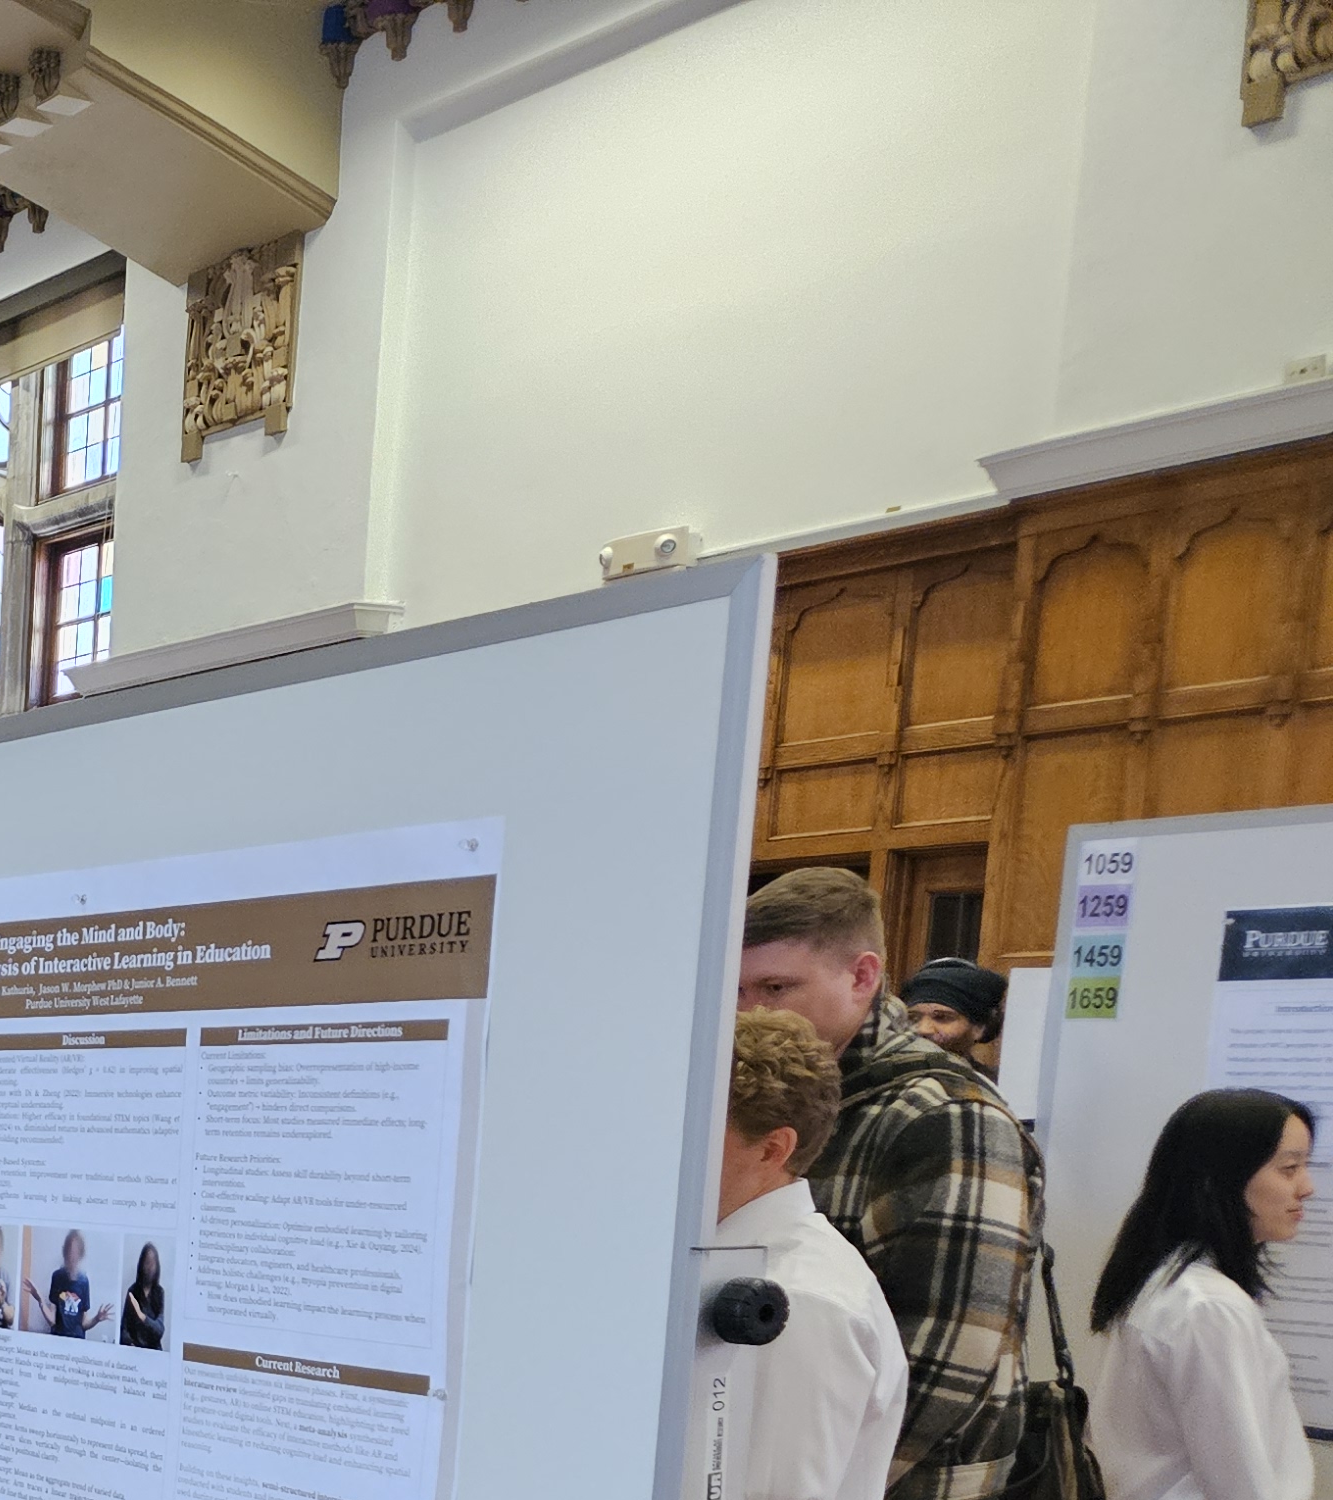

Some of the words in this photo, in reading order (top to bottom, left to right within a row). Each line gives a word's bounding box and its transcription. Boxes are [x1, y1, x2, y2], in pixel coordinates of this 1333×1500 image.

[1084, 852, 1134, 875] 1059
[1079, 894, 1129, 918] 1259
[57, 928, 79, 946] the
[81, 924, 115, 944] Mind
[117, 921, 143, 941] and
[146, 918, 185, 942] Body:
[371, 911, 471, 943] PURDUE
[1243, 930, 1330, 948] PURDUE
[21, 957, 37, 975] of
[38, 952, 111, 974] Interactive
[113, 947, 174, 971] Learning
[177, 945, 193, 965] in
[195, 940, 271, 963] Education
[370, 940, 469, 958] UNIVERSITY
[1073, 944, 1123, 968] 1459
[1, 984, 36, 996] Kathuria,
[38, 983, 60, 995] Jason
[61, 982, 72, 993] W.
[73, 980, 107, 994] Morphew
[108, 979, 123, 989] PhD
[124, 979, 130, 989] &
[131, 977, 155, 990] Junior
[156, 976, 164, 988] A.
[166, 975, 198, 987] Bennett
[25, 999, 53, 1009] Purdue
[54, 996, 91, 1009] University
[93, 994, 109, 1006] West
[110, 994, 143, 1007] Lafayette
[1068, 986, 1118, 1010] 1659
[61, 1032, 106, 1046] Discussion
[238, 1028, 293, 1041] Limitations
[293, 1026, 313, 1039] and
[314, 1026, 348, 1039] Future
[350, 1024, 403, 1038] Directions
[255, 1355, 293, 1372] Current
[295, 1361, 340, 1379] Research
[712, 1377, 726, 1411] 012
